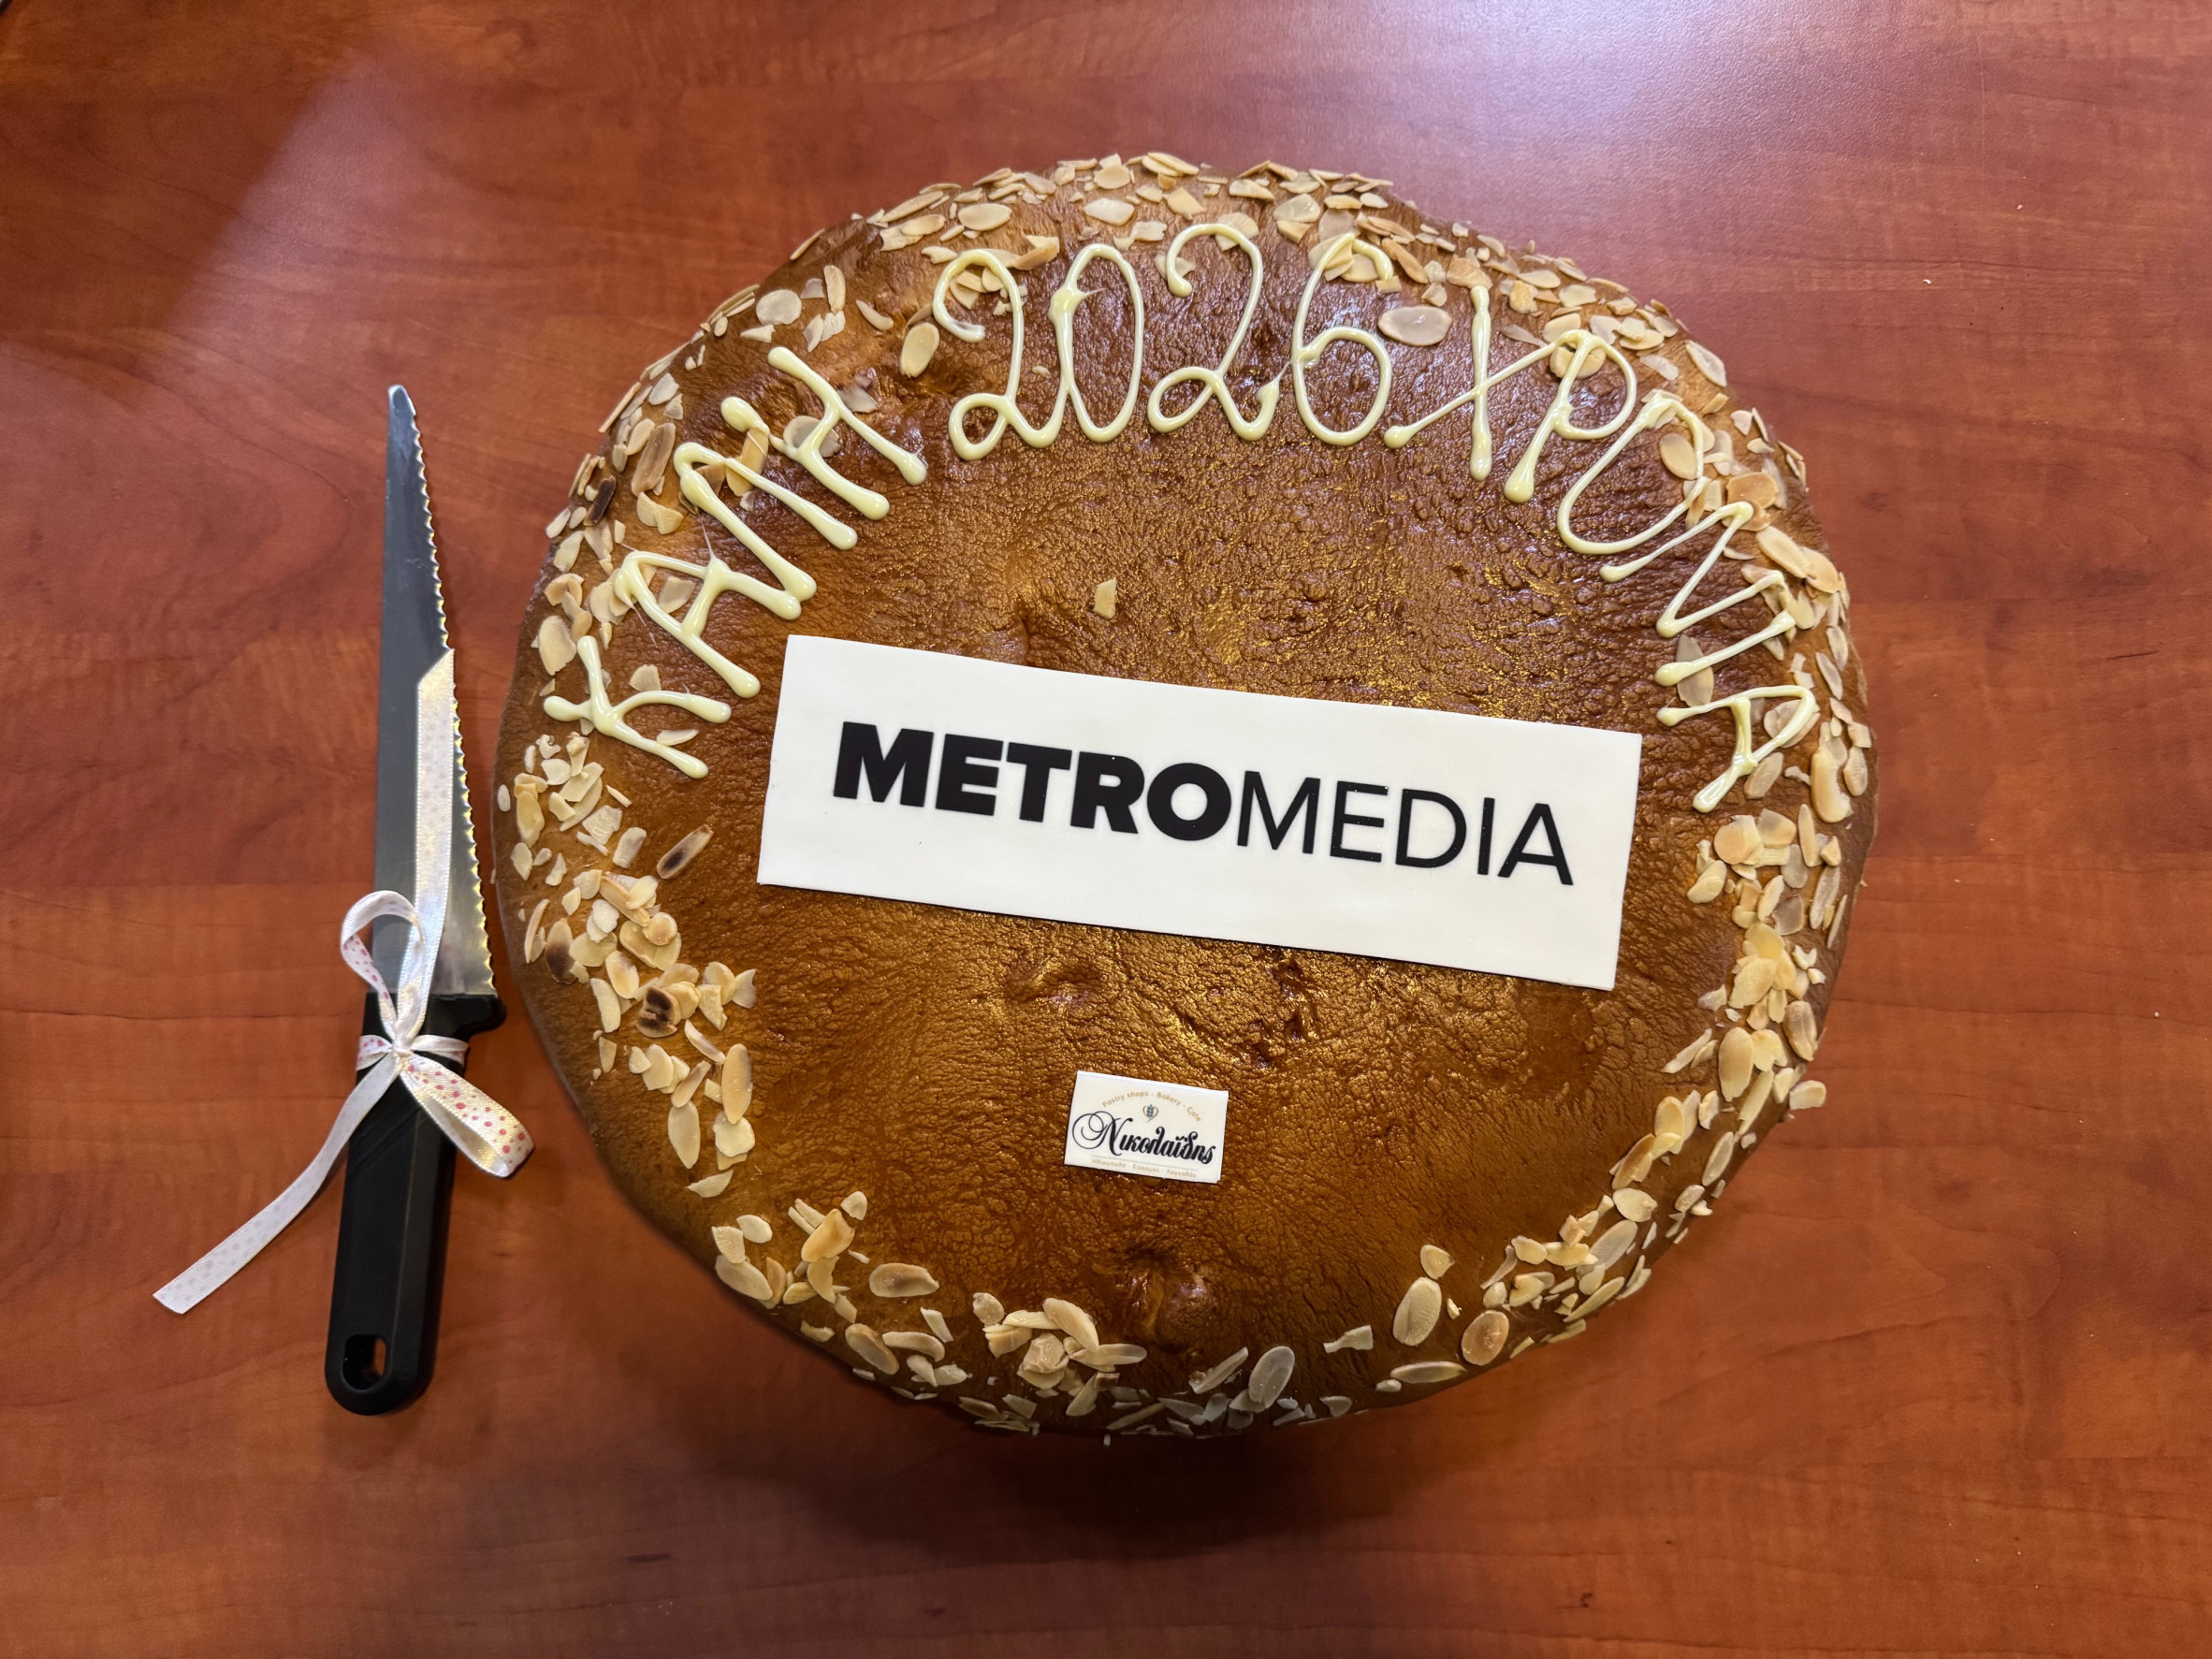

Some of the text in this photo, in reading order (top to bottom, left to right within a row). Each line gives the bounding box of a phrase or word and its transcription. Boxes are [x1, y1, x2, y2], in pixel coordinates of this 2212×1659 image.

[932, 224, 1394, 461] 2026
[833, 721, 1574, 886] METROMEDIA
[1101, 1094, 1125, 1108] Pastry
[1157, 1092, 1182, 1106] Bakery
